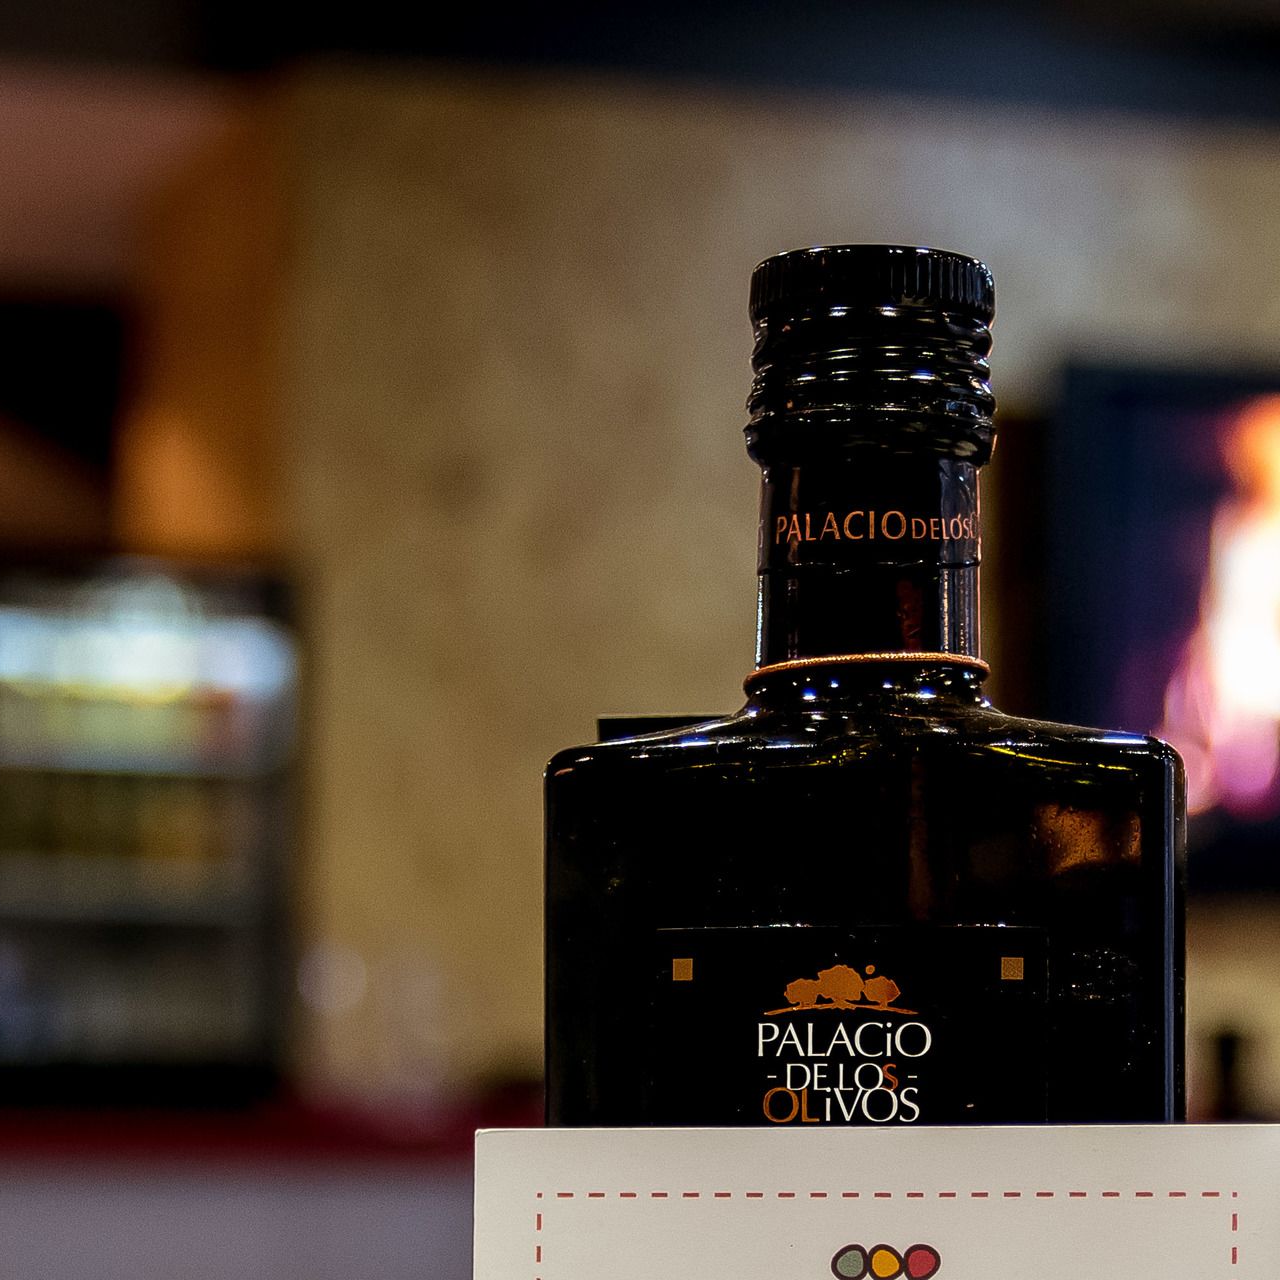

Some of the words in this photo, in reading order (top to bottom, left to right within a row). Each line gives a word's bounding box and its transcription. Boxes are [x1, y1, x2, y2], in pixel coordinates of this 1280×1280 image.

[776, 510, 907, 545] PALACIO
[757, 1022, 932, 1057] PALACiO
[786, 1063, 828, 1091] DE
[838, 1063, 899, 1091] LOS
[763, 1087, 920, 1123] OLiVOS
